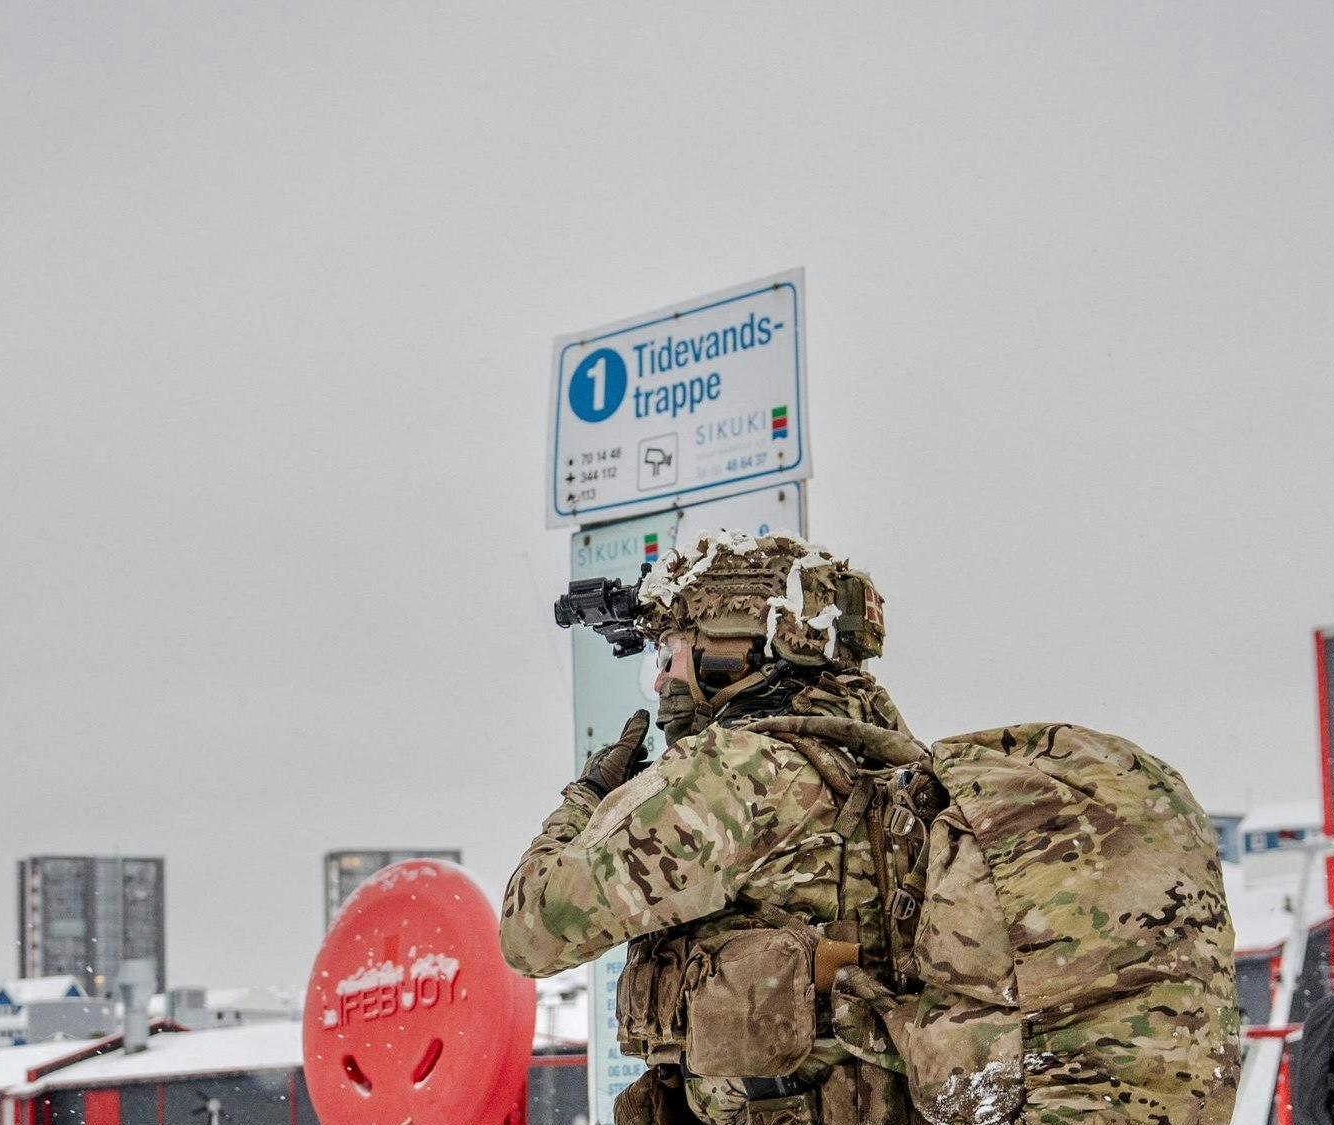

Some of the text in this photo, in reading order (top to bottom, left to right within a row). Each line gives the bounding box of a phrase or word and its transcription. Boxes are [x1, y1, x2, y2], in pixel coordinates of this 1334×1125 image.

[633, 312, 784, 378] Tidevands-
[586, 357, 607, 412] 1
[634, 371, 721, 418] trappe
[695, 409, 767, 446] SIKUKI
[578, 537, 638, 567] SIKUKI
[322, 964, 460, 1031] LIFEBUOY
